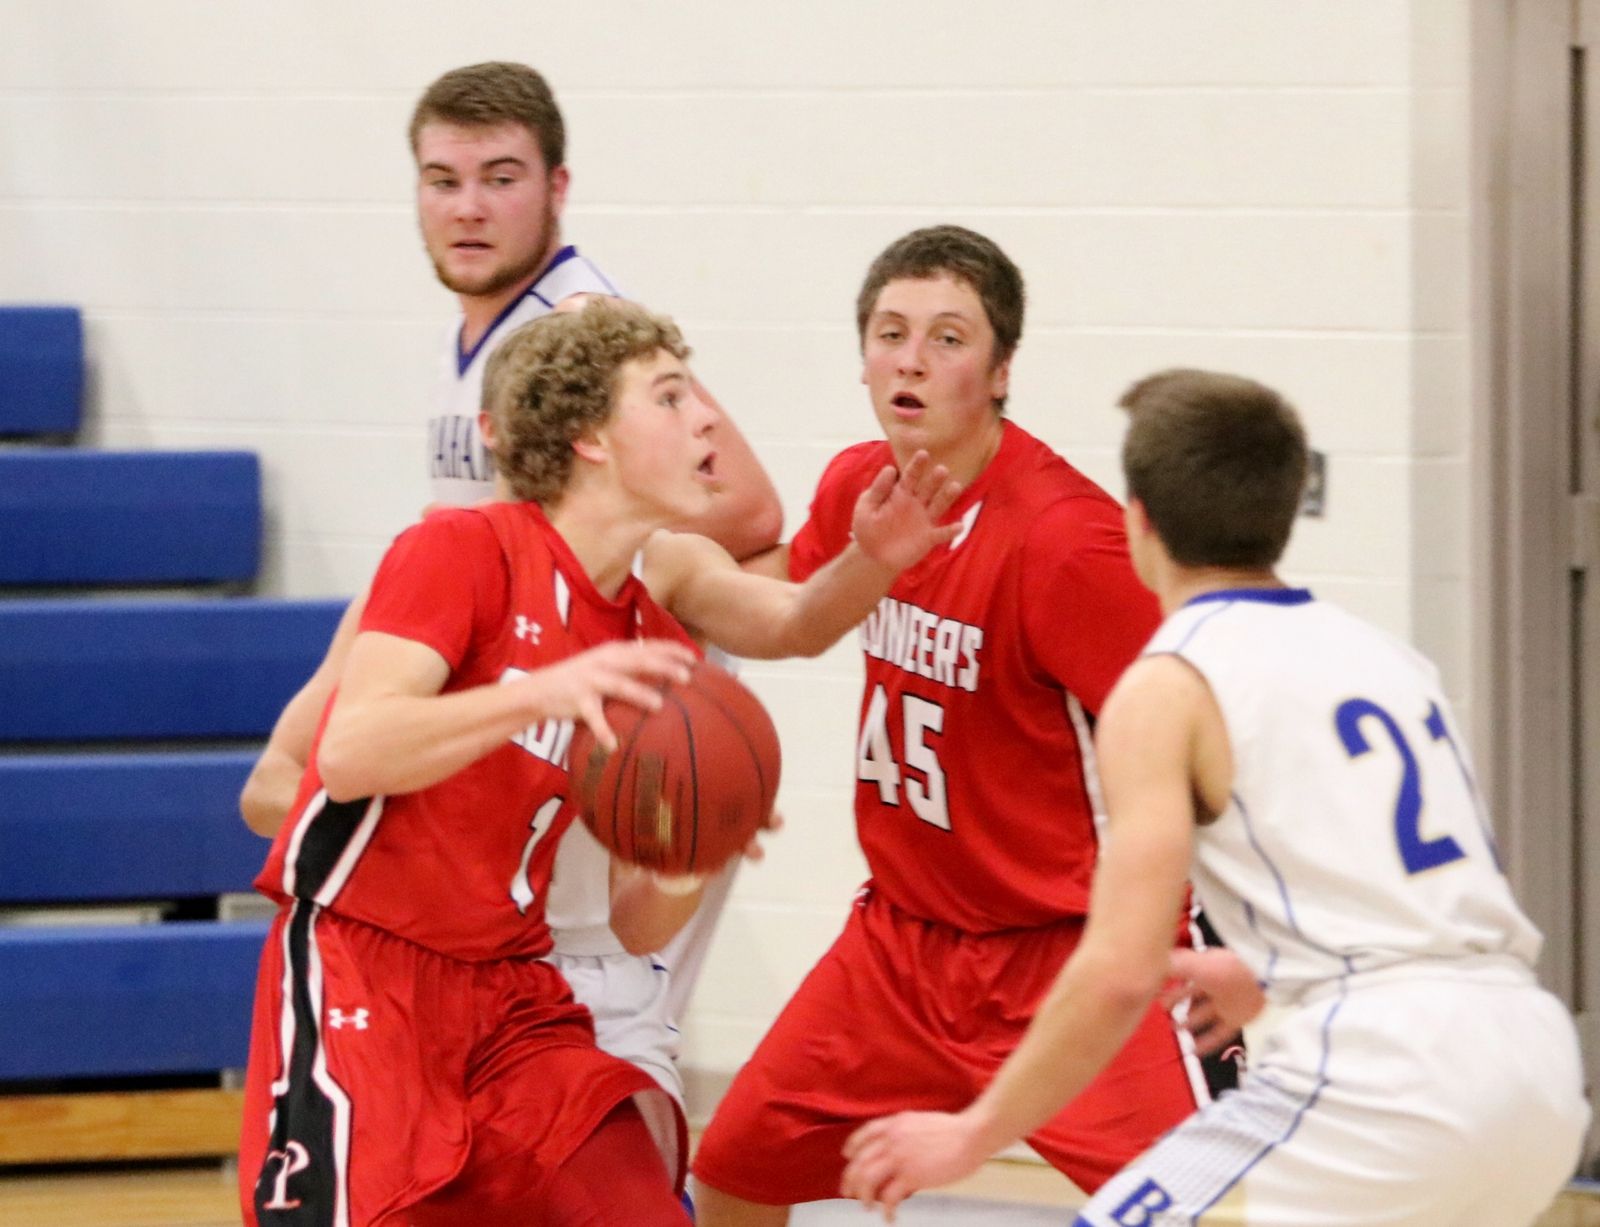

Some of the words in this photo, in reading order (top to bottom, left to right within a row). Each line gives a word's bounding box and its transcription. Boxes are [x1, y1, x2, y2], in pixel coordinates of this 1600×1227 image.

[857, 684, 952, 832] 45
[509, 795, 566, 916] 1
[262, 1139, 311, 1211] P
[1109, 1177, 1173, 1227] B
